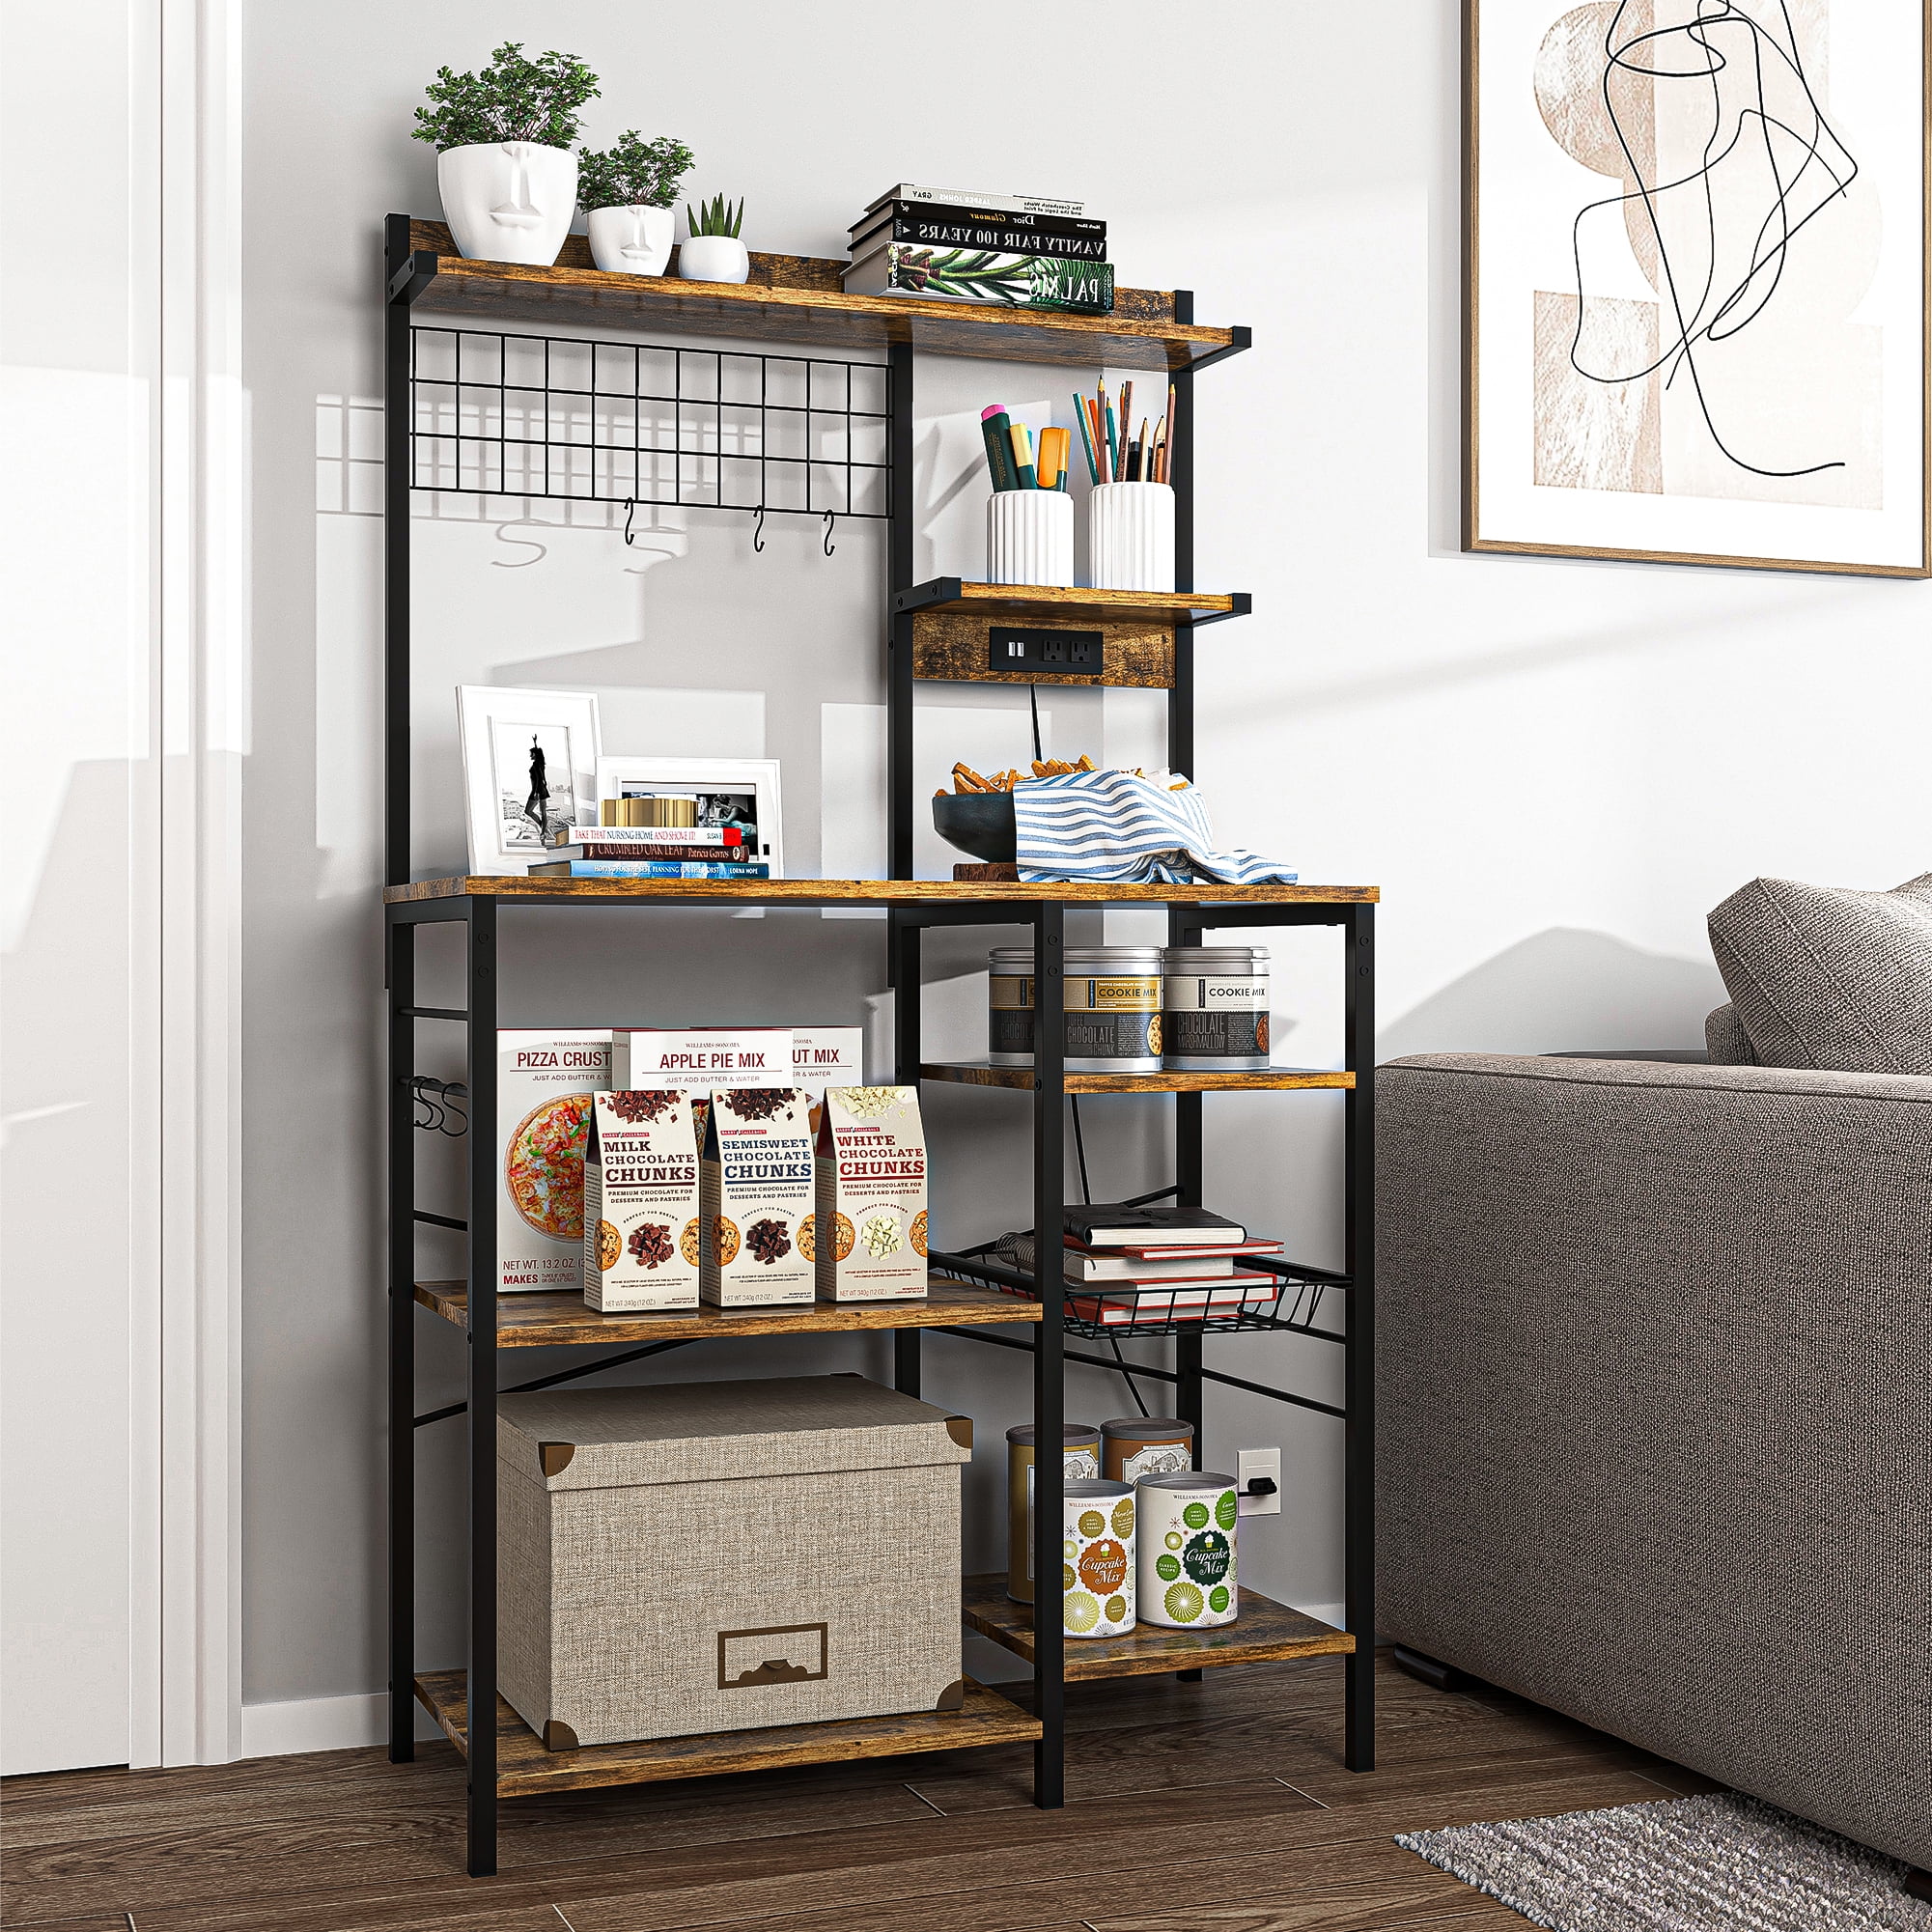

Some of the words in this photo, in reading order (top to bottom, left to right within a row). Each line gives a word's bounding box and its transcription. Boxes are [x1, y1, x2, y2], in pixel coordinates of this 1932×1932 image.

[574, 829, 589, 839] TAKE
[590, 829, 606, 840] THAT
[606, 829, 634, 840] NURSING
[634, 830, 654, 840] HOME
[654, 831, 668, 840] AND
[668, 830, 687, 841] SHOVE
[644, 844, 663, 855] OAK
[1099, 988, 1141, 997] COOKIE
[1142, 988, 1157, 997] MIX
[1209, 988, 1250, 996] COOKIE
[1251, 988, 1266, 996] MIX
[1178, 1013, 1225, 1035] CHOCOLATE
[1067, 1026, 1115, 1044] CHOCOLATE
[1178, 1034, 1226, 1050] MARSHMALLOW
[814, 1049, 839, 1063] MIX
[1093, 1044, 1115, 1056] CHUNK
[518, 1051, 558, 1067] PIZZA
[563, 1051, 611, 1067] CRUST
[659, 1053, 706, 1069] APPLE
[712, 1052, 734, 1068] PIE
[739, 1052, 765, 1068] MIX
[602, 1140, 652, 1153] MILK
[722, 1138, 808, 1150] SEMISWEET
[836, 1134, 896, 1147] WHITE
[604, 1154, 695, 1165] CHOCOLATE
[723, 1151, 811, 1162] CHOCOLATE
[839, 1148, 924, 1159] CHOCOLATE
[605, 1166, 696, 1183] CHUNKS
[724, 1162, 812, 1179] CHUNKS
[839, 1160, 925, 1176] CHUNKS
[503, 1260, 520, 1271] NET
[522, 1259, 540, 1270] WT.
[542, 1258, 560, 1269] 13.2
[503, 1274, 539, 1285] MAKES
[1186, 1547, 1228, 1565] Cupcake
[1081, 1555, 1125, 1574] Cupcake
[1198, 1559, 1225, 1576] Mix
[1094, 1569, 1122, 1584] Mix
